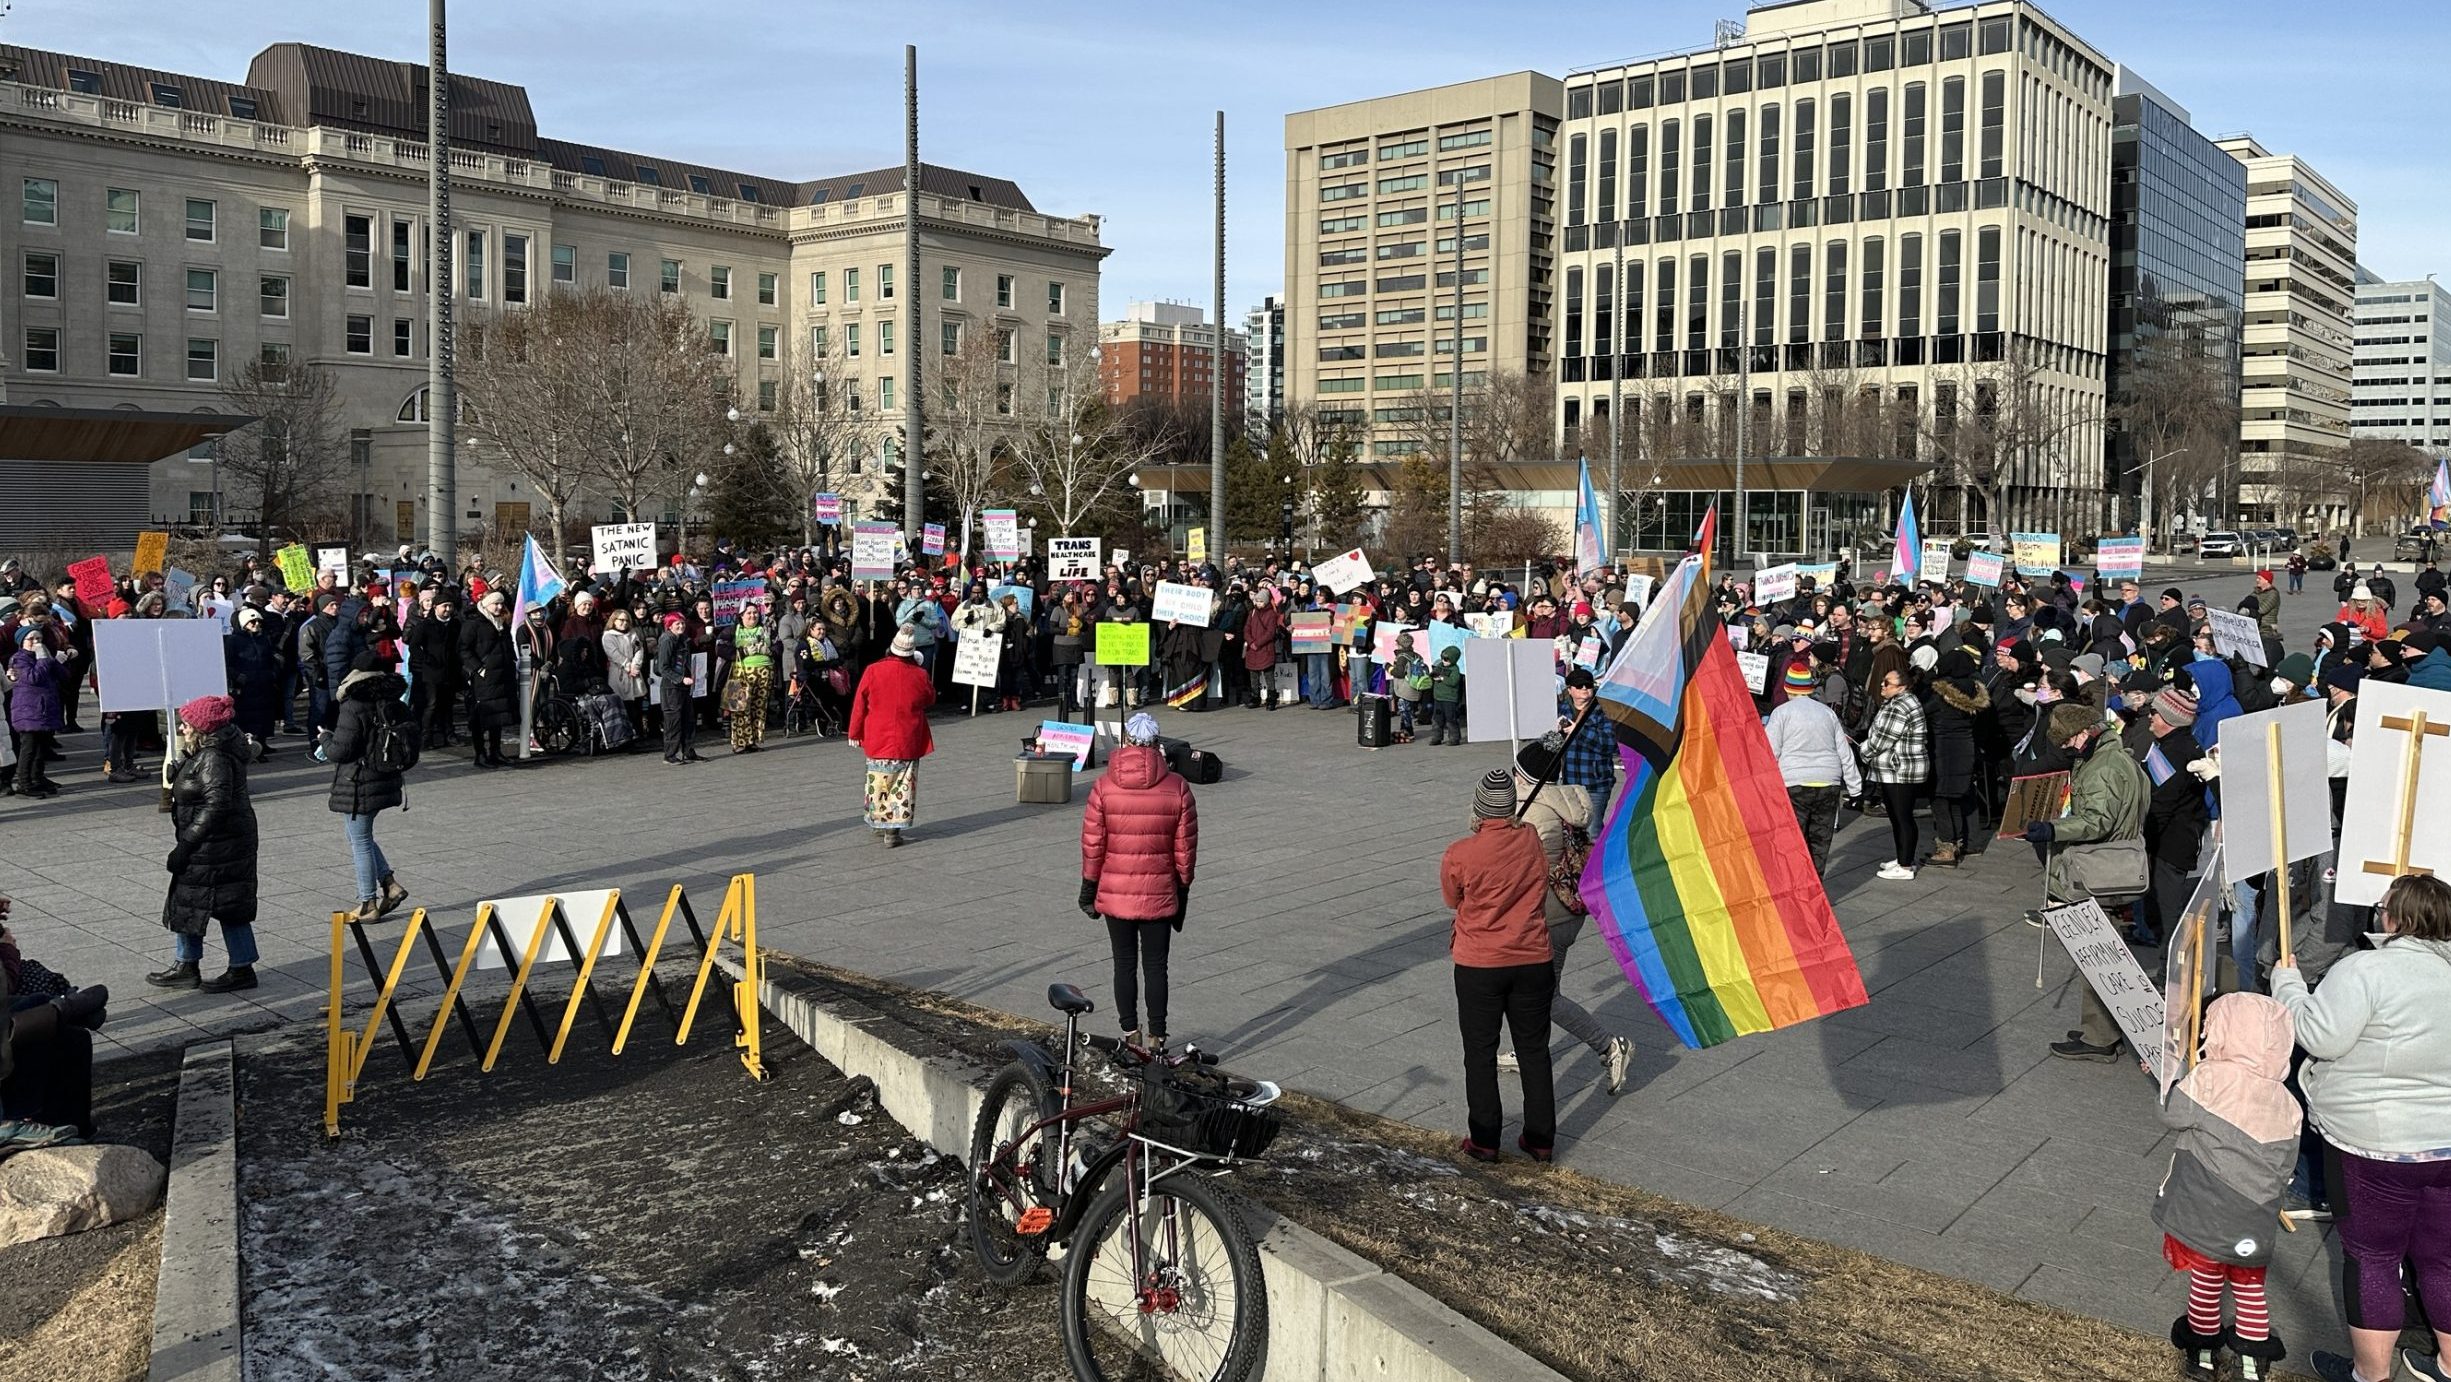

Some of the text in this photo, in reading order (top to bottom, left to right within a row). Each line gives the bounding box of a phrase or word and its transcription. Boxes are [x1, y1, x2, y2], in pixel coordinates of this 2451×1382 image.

[597, 524, 652, 537] THE NEW
[601, 537, 649, 554] SATANIC
[1055, 540, 1092, 550] TRANS
[612, 553, 645, 567] PANIC
[1050, 551, 1096, 559] HEALTHCARE
[71, 558, 107, 573] GENDER
[1059, 567, 1088, 577] LIFE
[84, 582, 108, 597] SAVES
[719, 582, 738, 594] LET
[1161, 586, 1207, 599] THEIR BODY
[714, 593, 741, 603] TRANS
[1180, 601, 1203, 611] CHILD
[1155, 608, 1207, 623] THEIR CHOICE
[2210, 611, 2248, 629] Remove UCP
[960, 630, 979, 644] Human
[2053, 904, 2105, 939] GENDER
[2075, 940, 2134, 968] AFFIRMING
[2098, 971, 2135, 996] CARE
